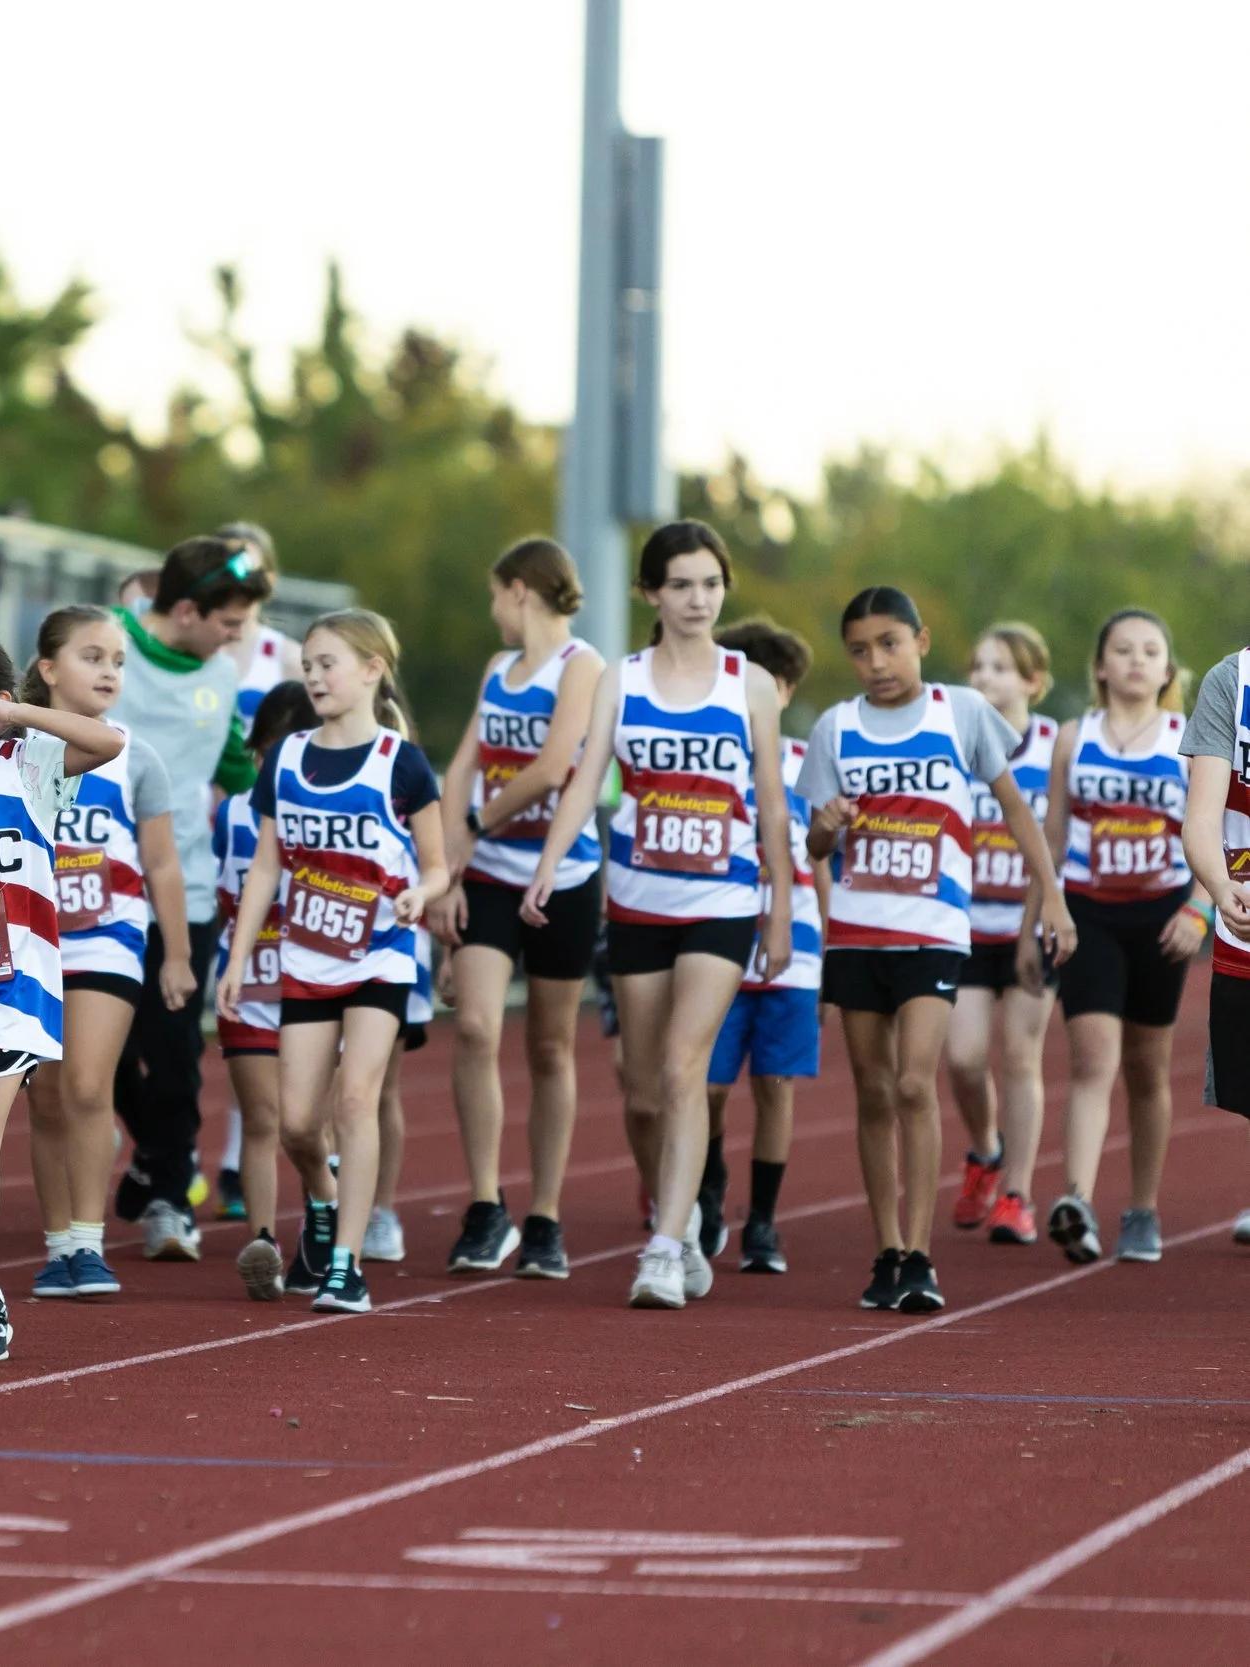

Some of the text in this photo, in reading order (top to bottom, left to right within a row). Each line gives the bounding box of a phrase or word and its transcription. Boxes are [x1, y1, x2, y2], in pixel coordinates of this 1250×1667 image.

[643, 813, 723, 857] 1863
[1098, 836, 1167, 874] 1912
[852, 837, 934, 880] 1859
[291, 890, 368, 944] 1855
